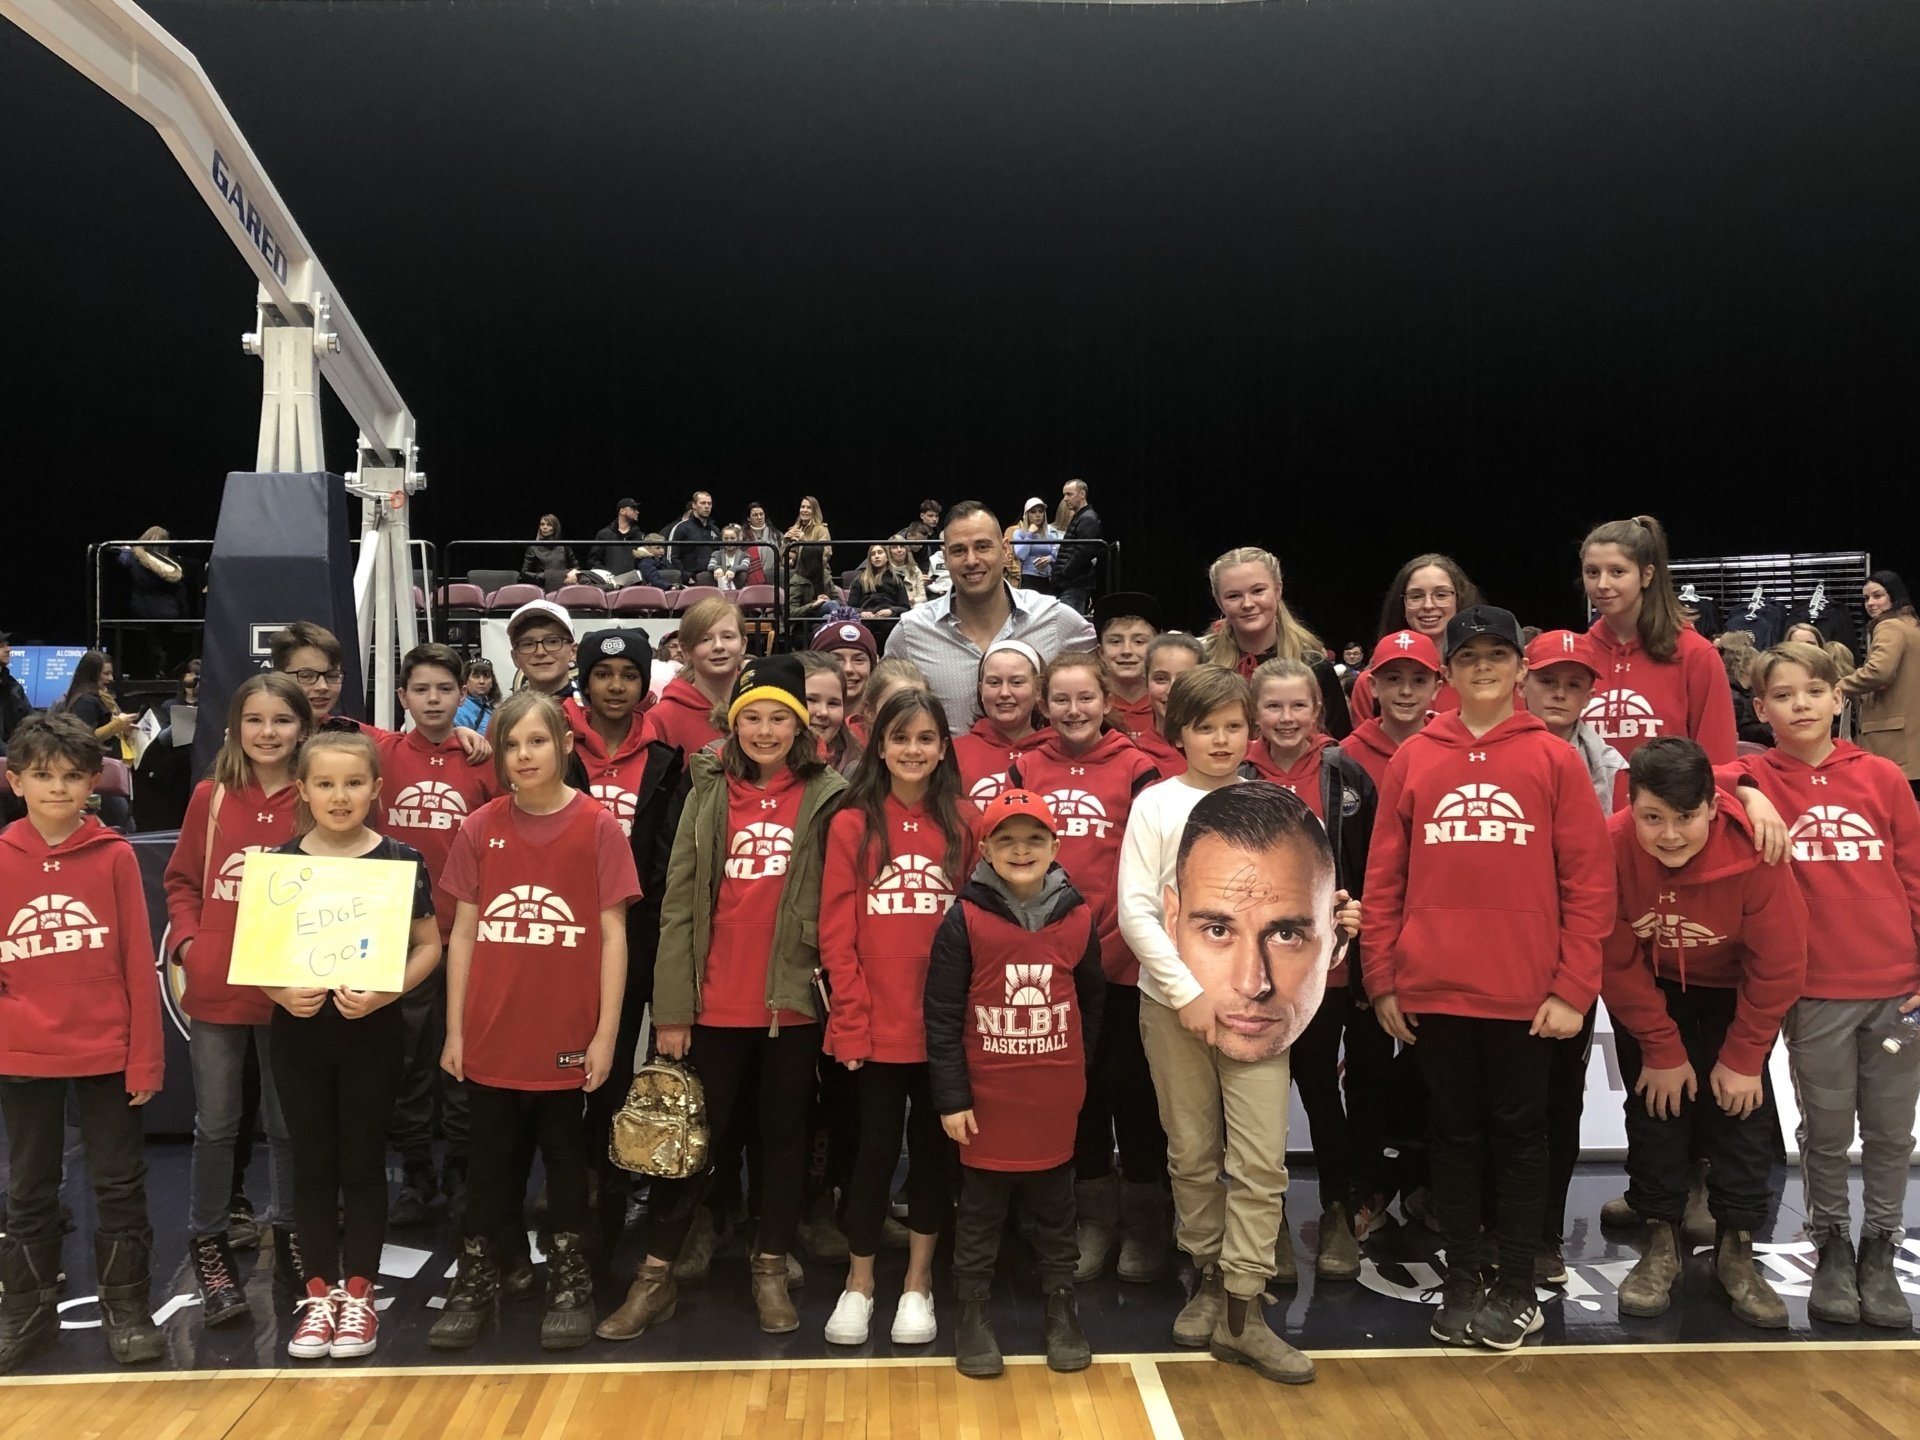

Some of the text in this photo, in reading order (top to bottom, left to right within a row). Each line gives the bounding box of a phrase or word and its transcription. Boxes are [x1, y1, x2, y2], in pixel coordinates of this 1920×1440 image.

[213, 150, 288, 286] GARED
[1563, 633, 1574, 653] H
[1424, 820, 1536, 846] NLBT
[725, 855, 791, 879] NLB
[296, 896, 367, 936] EDGE
[0, 926, 110, 963] NLBT
[477, 920, 586, 948] NLBT
[975, 1001, 1071, 1037] NLBT
[983, 1033, 1068, 1055] BASKETBALL
